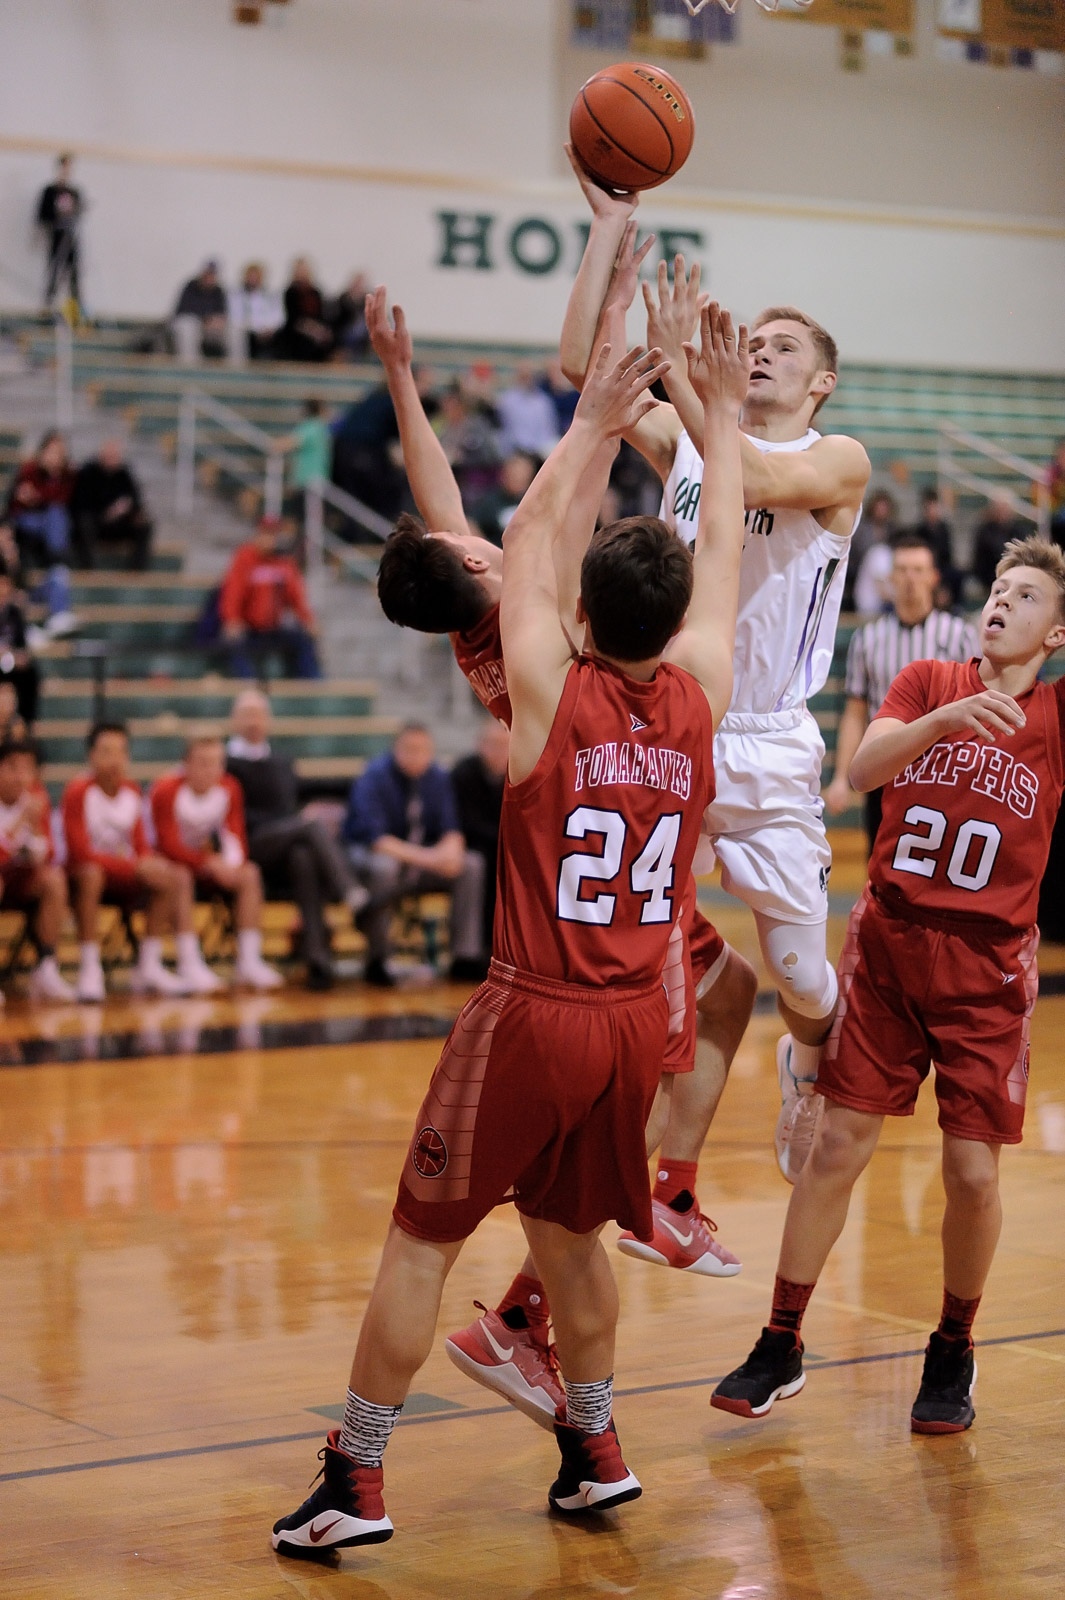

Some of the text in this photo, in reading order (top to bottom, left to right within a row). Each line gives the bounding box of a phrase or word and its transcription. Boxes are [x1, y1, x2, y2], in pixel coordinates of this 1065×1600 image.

[437, 210, 704, 282] HOE
[575, 742, 692, 800] TOMAHAWKS
[894, 741, 1039, 819] MPHS
[556, 805, 683, 925] 24
[892, 804, 1002, 892] 20
